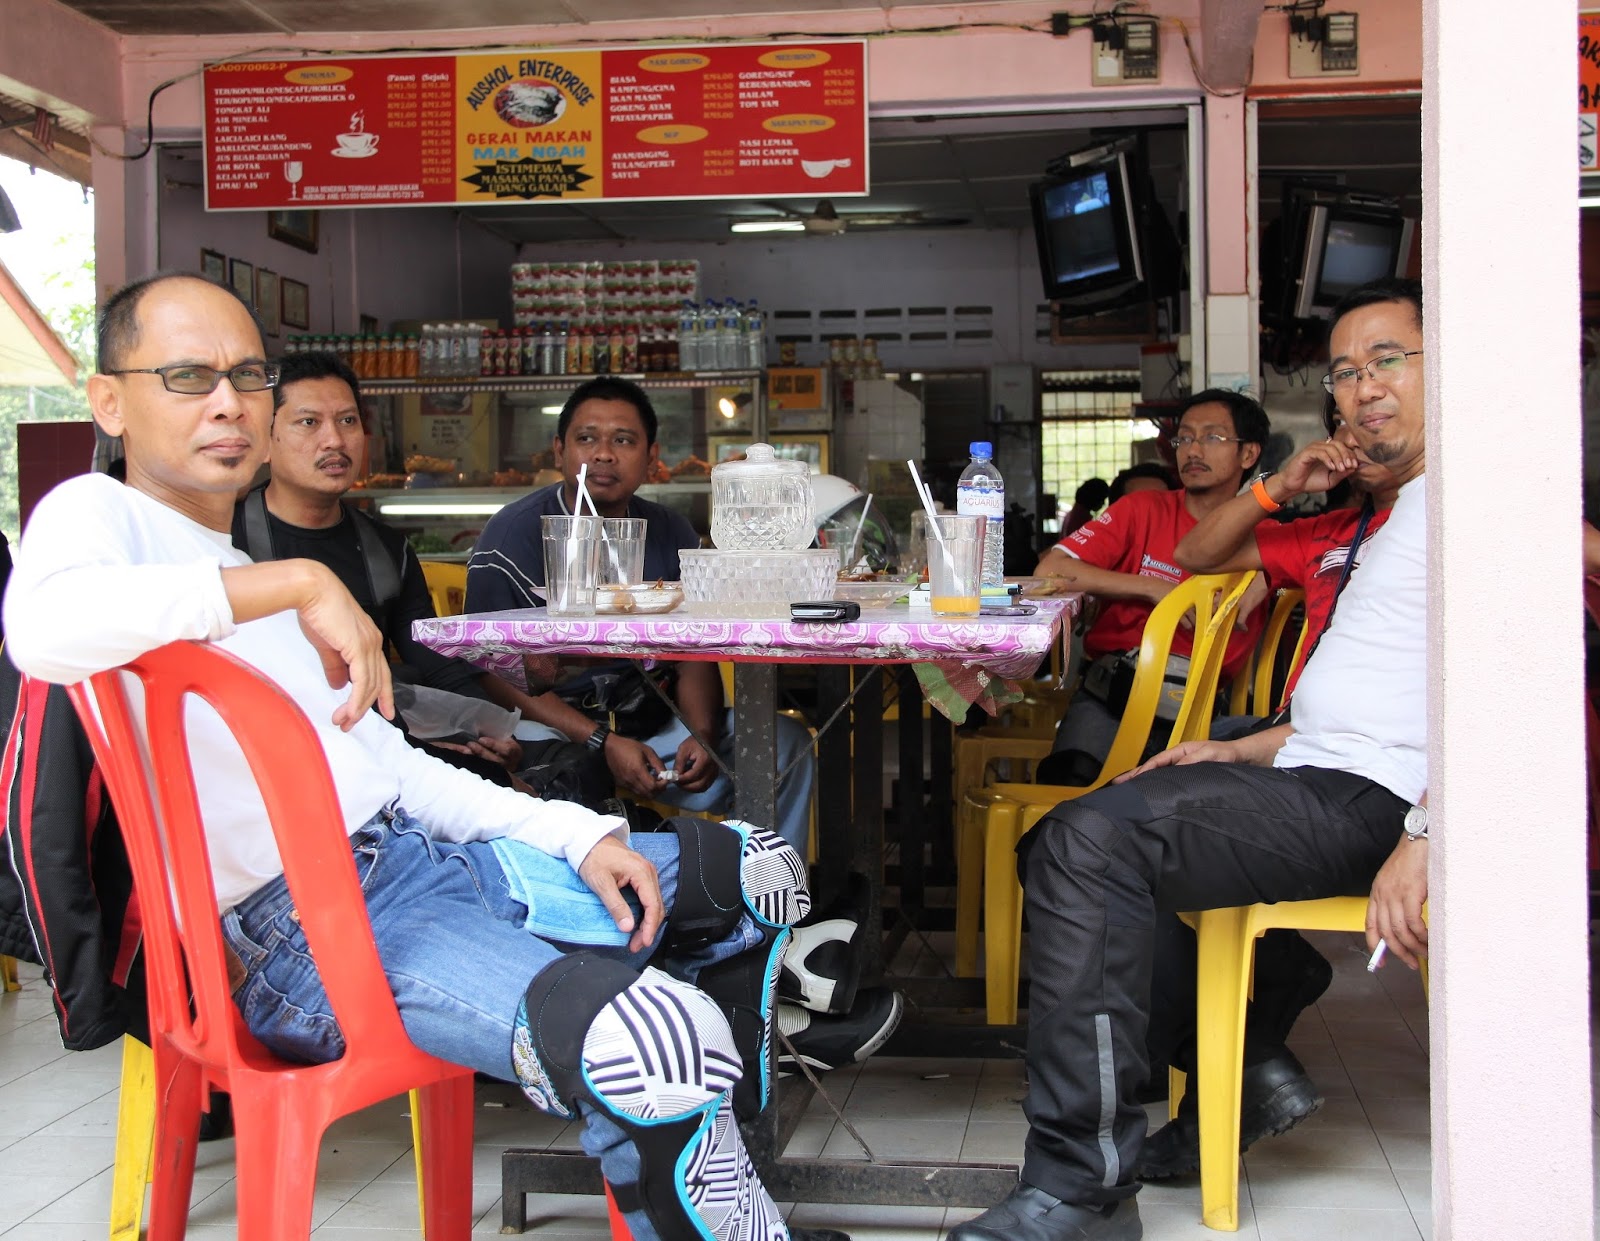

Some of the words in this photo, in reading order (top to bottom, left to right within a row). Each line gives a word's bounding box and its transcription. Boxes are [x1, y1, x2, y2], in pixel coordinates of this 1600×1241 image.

[466, 65, 514, 111] AUSHOL
[519, 59, 595, 107] ENTERPRISE
[610, 76, 637, 84] BIASA
[610, 95, 632, 103] IKAN
[634, 93, 662, 102] MASIN
[610, 103, 646, 112] GORENG
[648, 103, 672, 111] AYAM
[761, 100, 779, 108] YAM
[215, 106, 252, 114] TONGKAT
[466, 132, 517, 145] GERAI
[525, 130, 592, 144] MAKAN
[739, 139, 760, 147] NASI
[762, 138, 794, 146] LEMAK
[473, 147, 519, 160] MAK
[532, 146, 586, 158] NGAH
[739, 149, 760, 157] NASI
[762, 148, 800, 156] CAMPUR
[496, 164, 564, 174] ISTIMEWA
[216, 173, 247, 181] KELAPA
[481, 174, 536, 184] MASAKAN
[538, 174, 575, 183] PANAS
[611, 171, 640, 179] SAYUR
[489, 183, 526, 193] UDANG
[528, 183, 567, 192] GALAH
[963, 497, 1000, 507] AQUARIUS
[1149, 560, 1181, 576] MICHELIN
